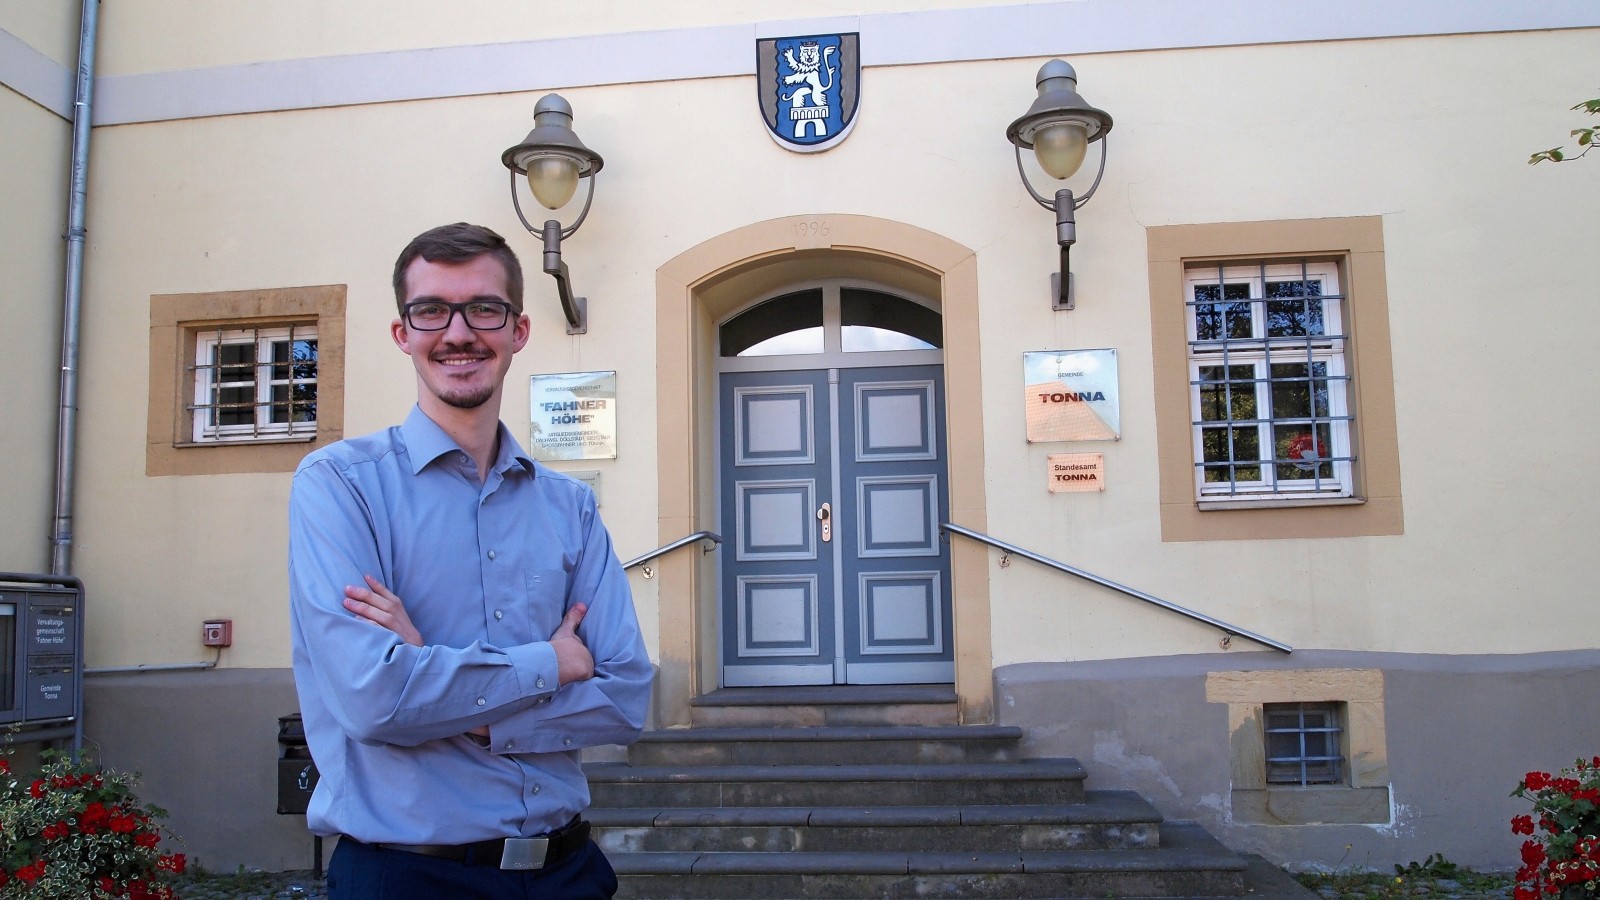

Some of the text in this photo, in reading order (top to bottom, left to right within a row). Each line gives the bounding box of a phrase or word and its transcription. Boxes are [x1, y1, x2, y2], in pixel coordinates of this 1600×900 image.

[792, 221, 830, 237] 1996
[1038, 391, 1106, 404] TONNA
[540, 399, 607, 412] "FAHNER
[551, 413, 595, 424] HÖHE"
[1055, 473, 1098, 482] TONNA
[40, 684, 62, 692] Gemeinde
[44, 692, 58, 700] Tonna
